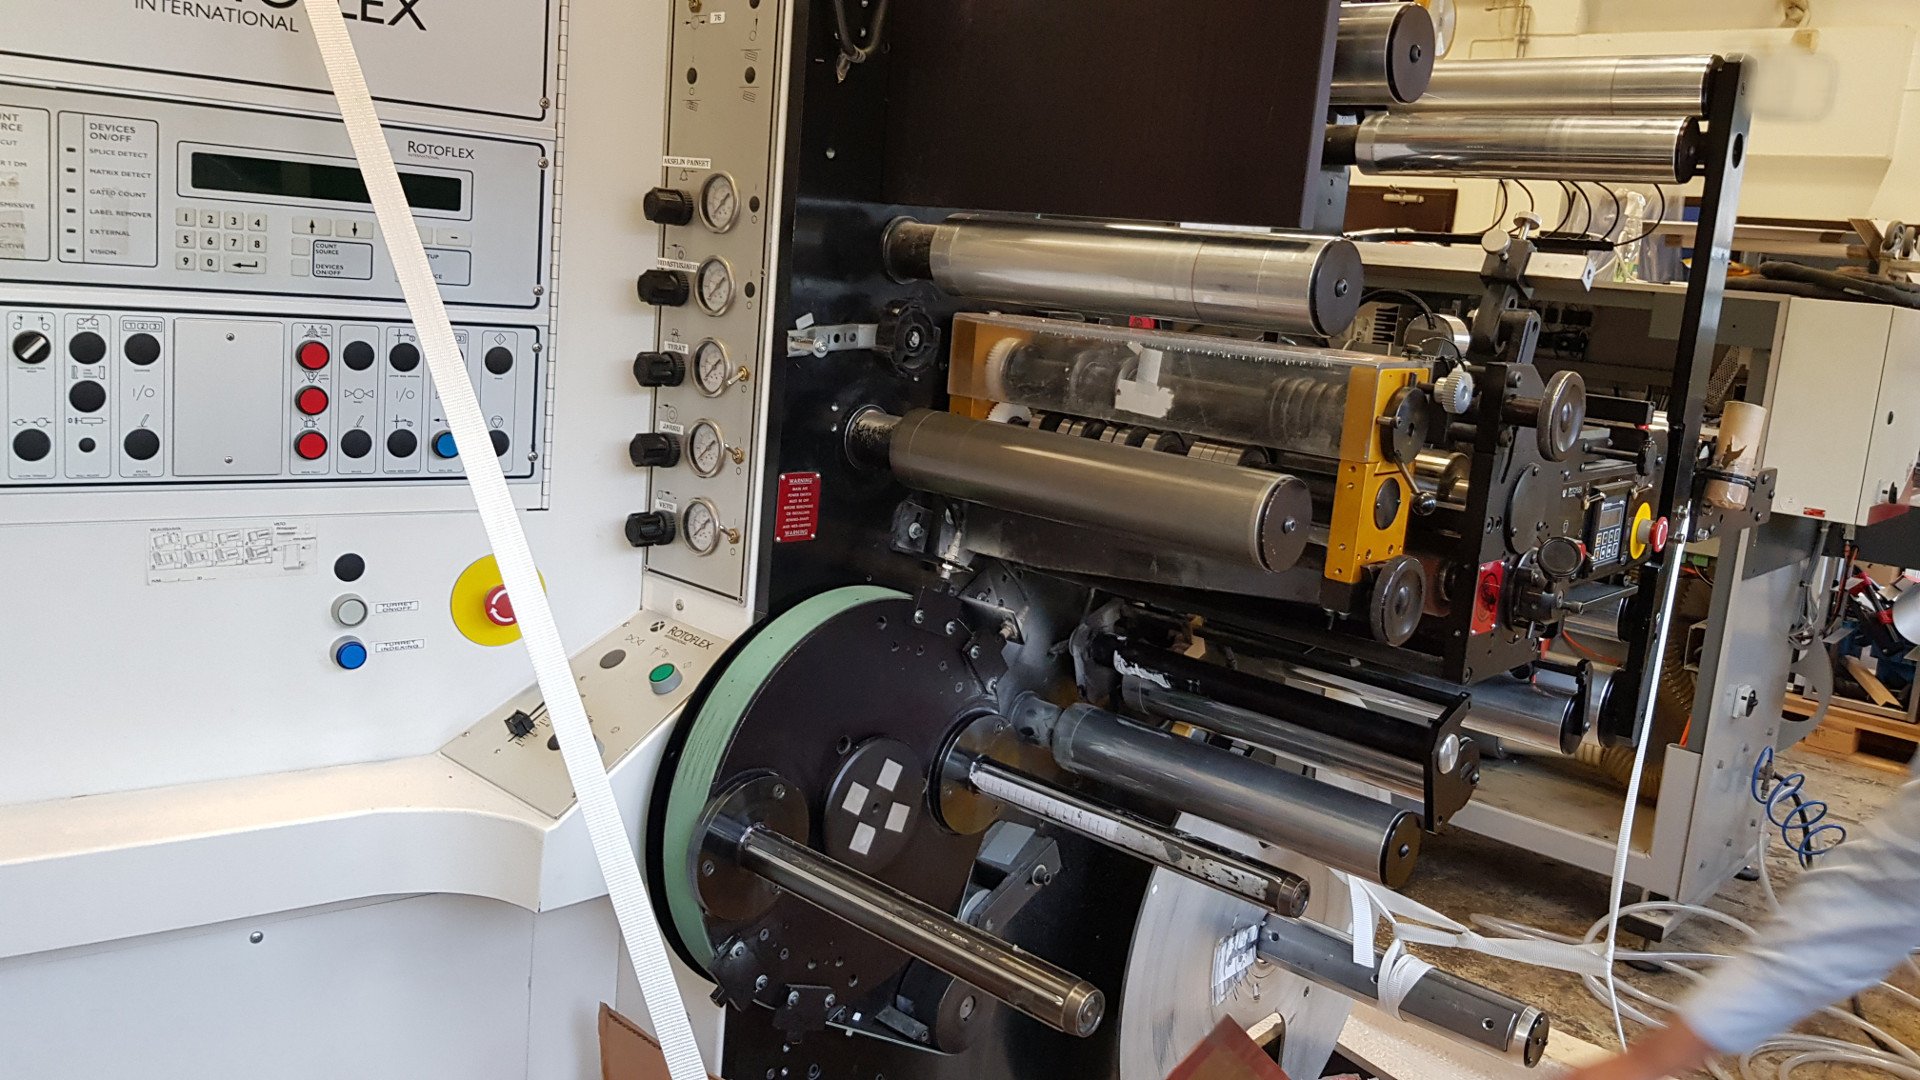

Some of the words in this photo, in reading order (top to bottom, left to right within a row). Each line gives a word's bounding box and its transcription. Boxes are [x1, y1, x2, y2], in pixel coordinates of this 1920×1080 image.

[134, 0, 299, 32] INTERNATIONAL
[713, 14, 722, 22] 76
[89, 122, 136, 134] DEVICES
[89, 132, 132, 142] ON/OFF
[89, 148, 116, 156] SPLICE
[118, 150, 149, 159] DETECT
[407, 140, 475, 160] ROTOFLEX
[89, 168, 119, 176] MATRIX
[121, 171, 152, 179] DETECT
[118, 190, 147, 198] COUNT
[116, 210, 152, 218] REMOVER
[184, 213, 188, 221] 1
[207, 215, 213, 223] 2
[231, 217, 237, 225] 3
[254, 219, 260, 227] 4
[89, 229, 131, 237] EXTERNAL
[183, 235, 189, 243] 5
[207, 237, 213, 245] 6
[231, 238, 237, 247] 7
[254, 240, 260, 248] 8
[183, 257, 189, 265] 9
[207, 258, 213, 267] 0
[667, 626, 715, 650] ROTOFLEX
[381, 644, 419, 652] INDEXING
